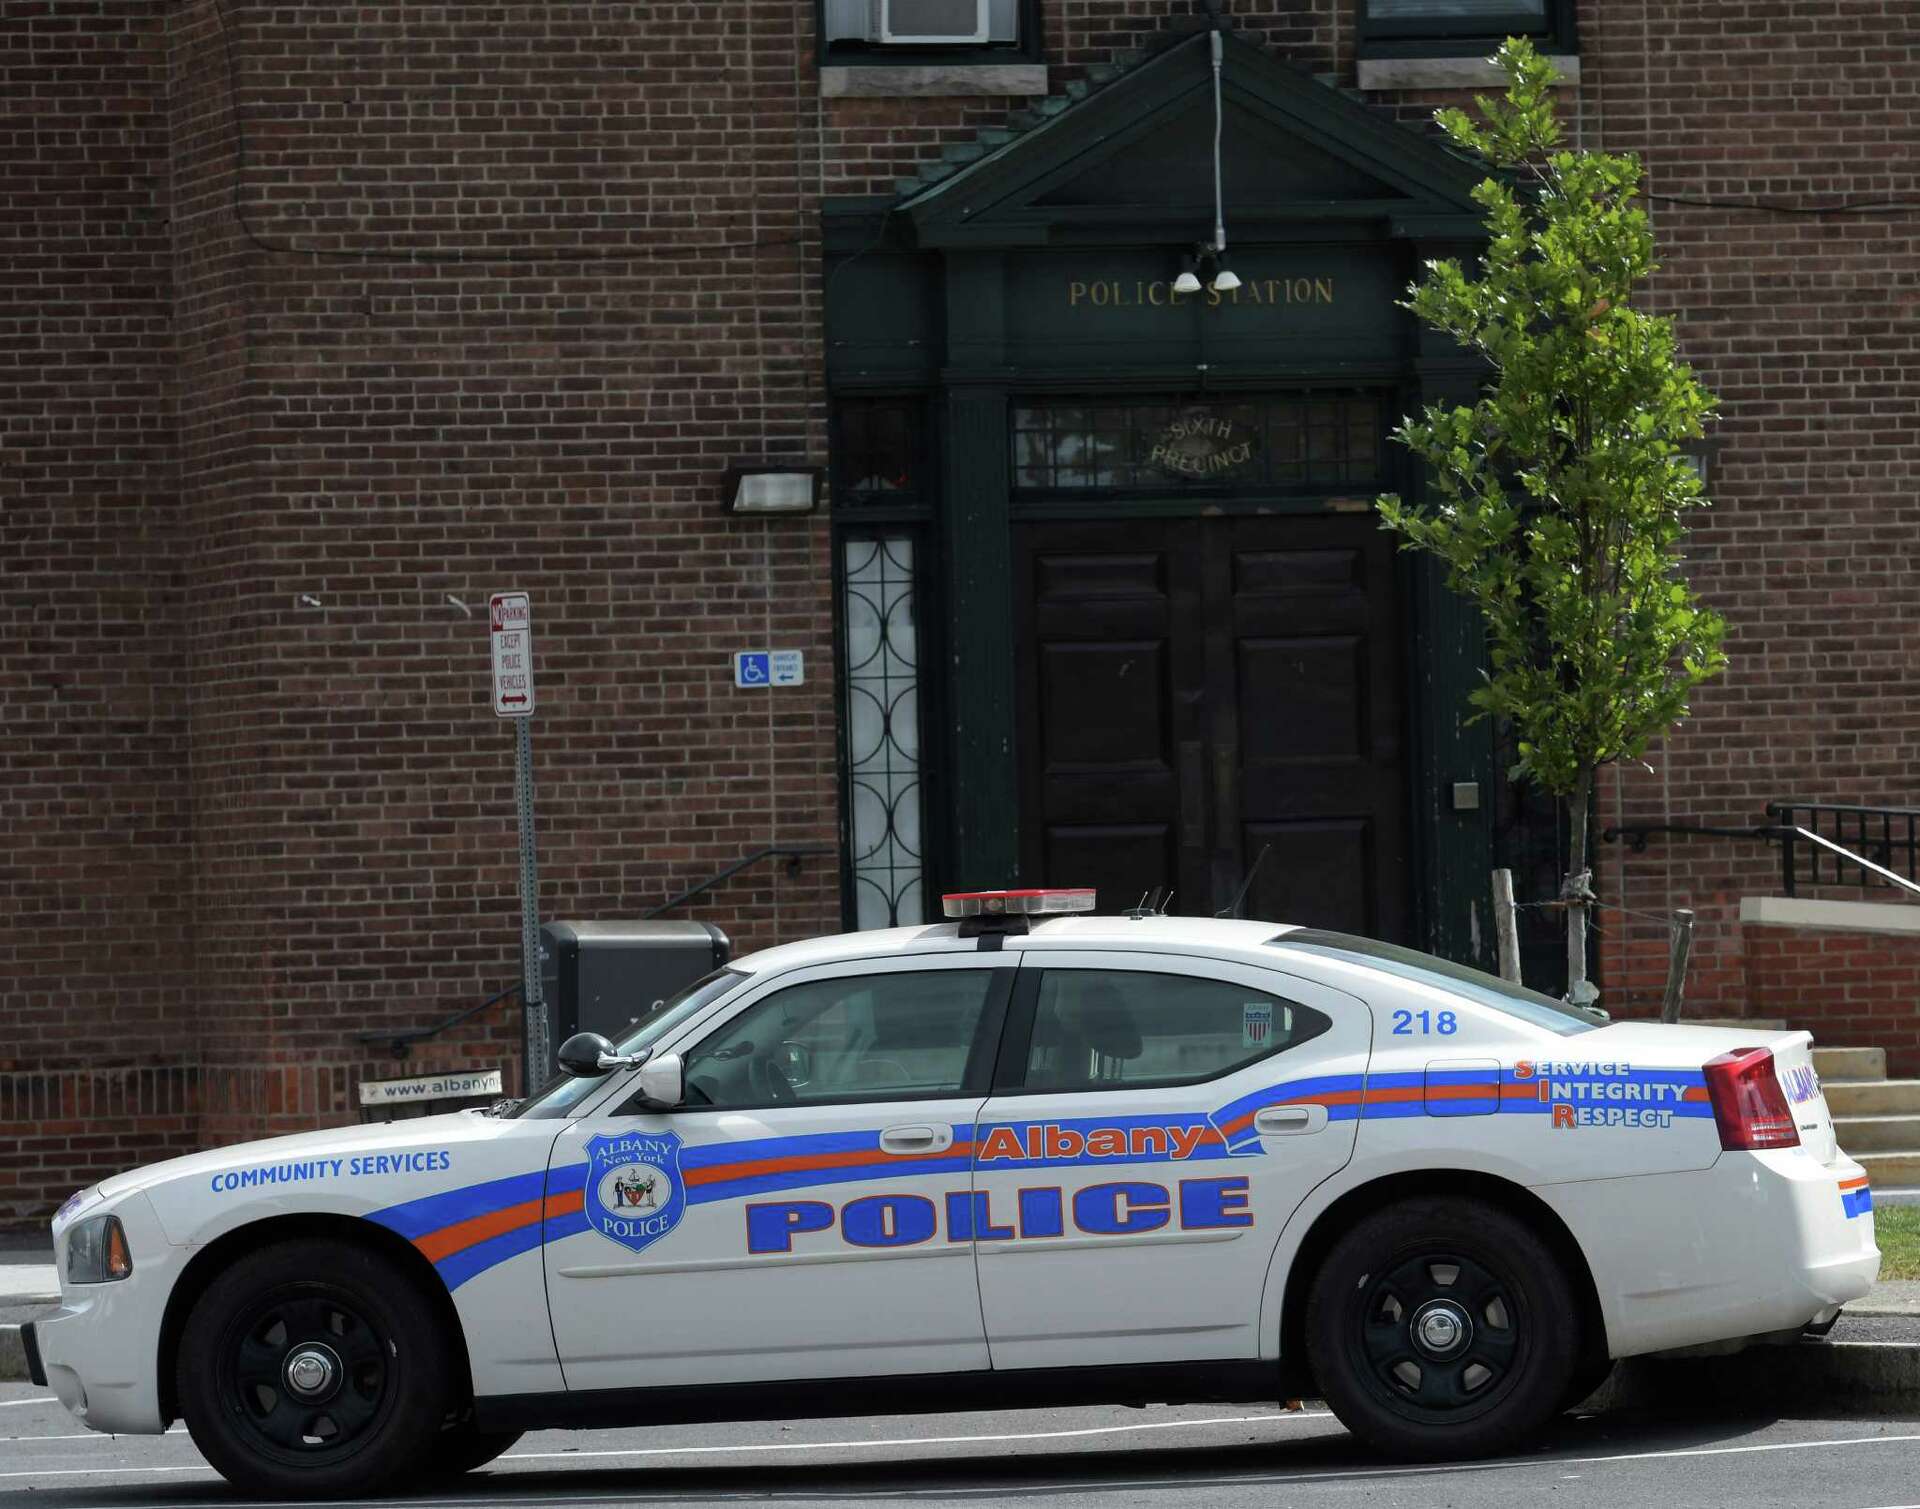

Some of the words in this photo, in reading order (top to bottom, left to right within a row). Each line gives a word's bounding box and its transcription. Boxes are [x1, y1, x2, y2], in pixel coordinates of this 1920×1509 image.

[1070, 280, 1187, 306] POLICE
[1170, 416, 1233, 440] SIXTH
[1151, 442, 1250, 473] PRECINCT
[503, 606, 526, 620] PARKING
[500, 633, 520, 649] EXCEPT
[501, 654, 521, 669] POLICE
[499, 675, 526, 690] VEHICLES
[1392, 1009, 1457, 1035] 218
[1514, 1060, 1630, 1079] SERVICE
[1538, 1078, 1688, 1103] INTEGRITY
[1552, 1103, 1674, 1130] RESPECT
[596, 1139, 671, 1159] ALBANY
[979, 1121, 1205, 1162] Albany
[211, 1159, 344, 1193] COMMUNITY
[350, 1150, 451, 1175] SERVICES
[603, 1154, 632, 1168] New
[635, 1152, 665, 1165] York
[603, 1214, 670, 1237] POLICE
[745, 1175, 1255, 1255] POLICE
